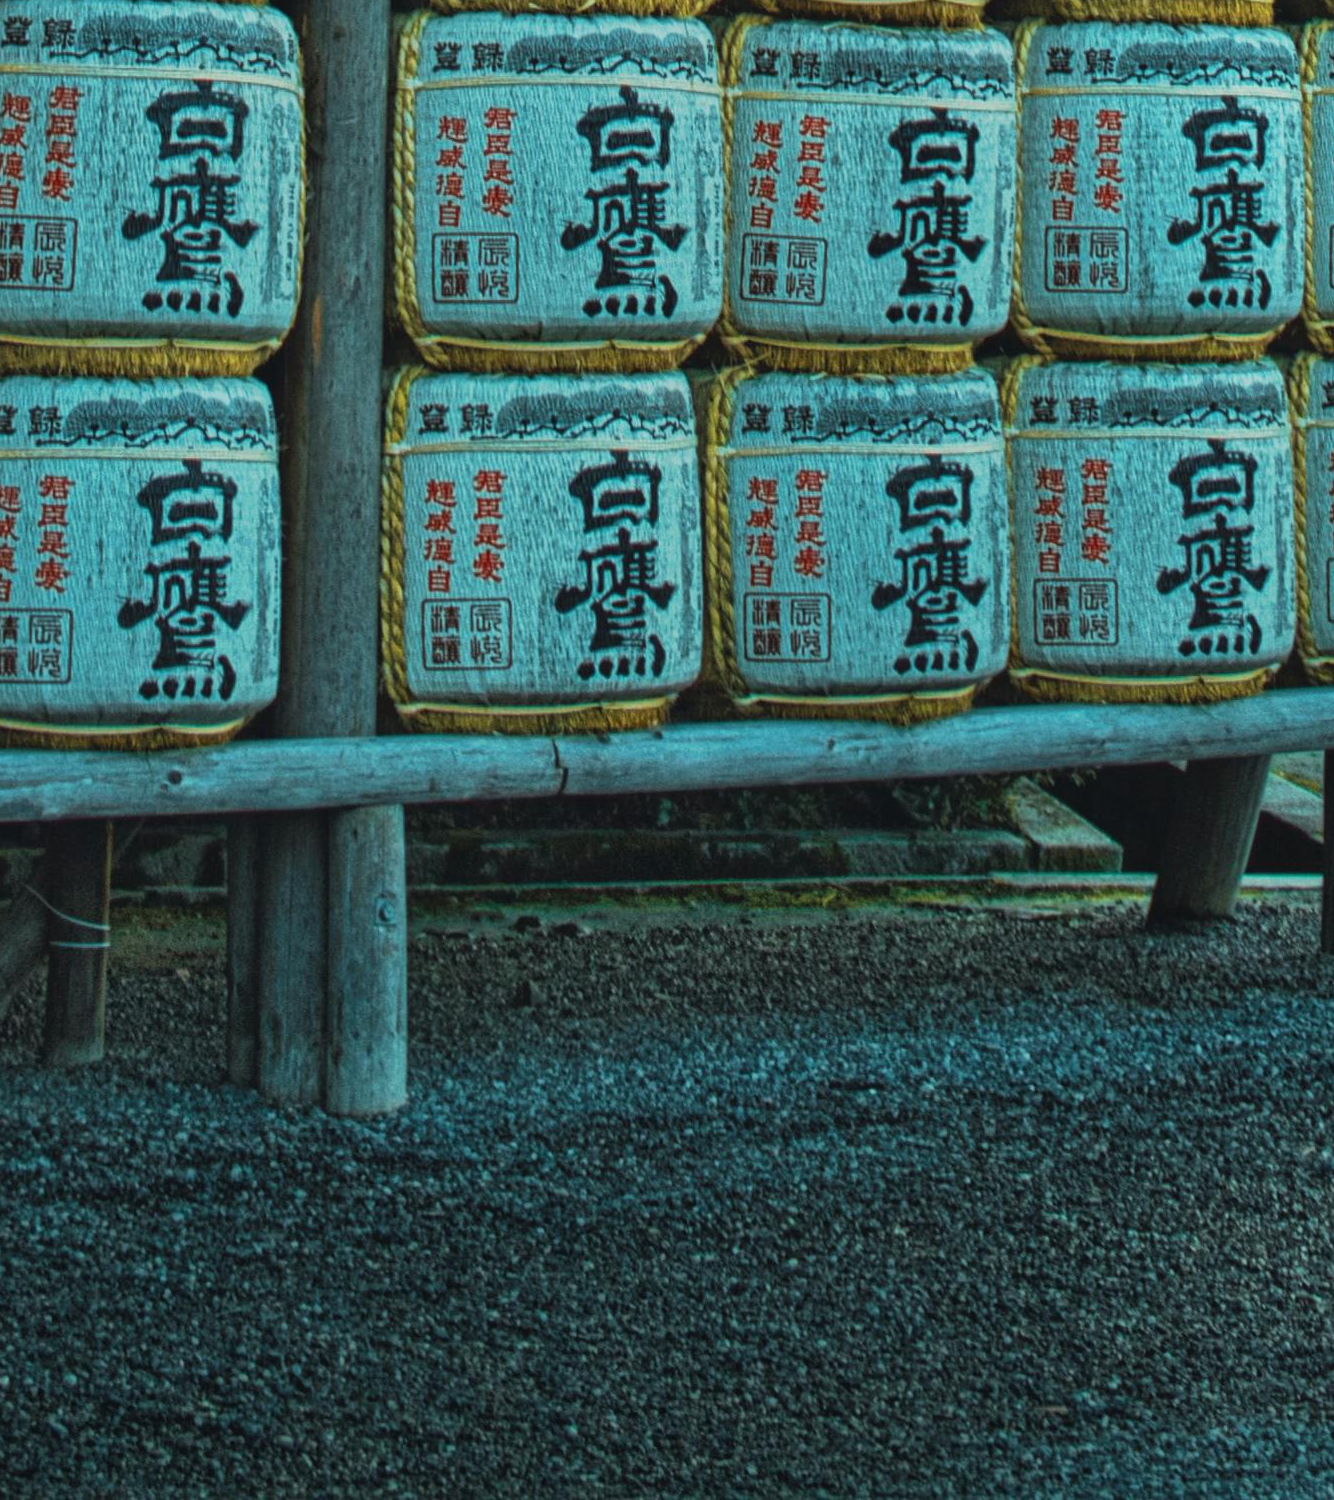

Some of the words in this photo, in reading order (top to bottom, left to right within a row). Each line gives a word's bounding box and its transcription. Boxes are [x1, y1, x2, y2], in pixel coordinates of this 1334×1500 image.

[122, 80, 258, 317] 白鷹
[561, 86, 687, 318] 白鷹
[868, 108, 985, 326] 白鷹
[1168, 96, 1279, 310] 白鷹
[118, 459, 248, 700] 白鷹
[554, 450, 675, 680] 白鷹
[872, 455, 987, 675] 白鷹
[1157, 439, 1269, 656] 白鷹
